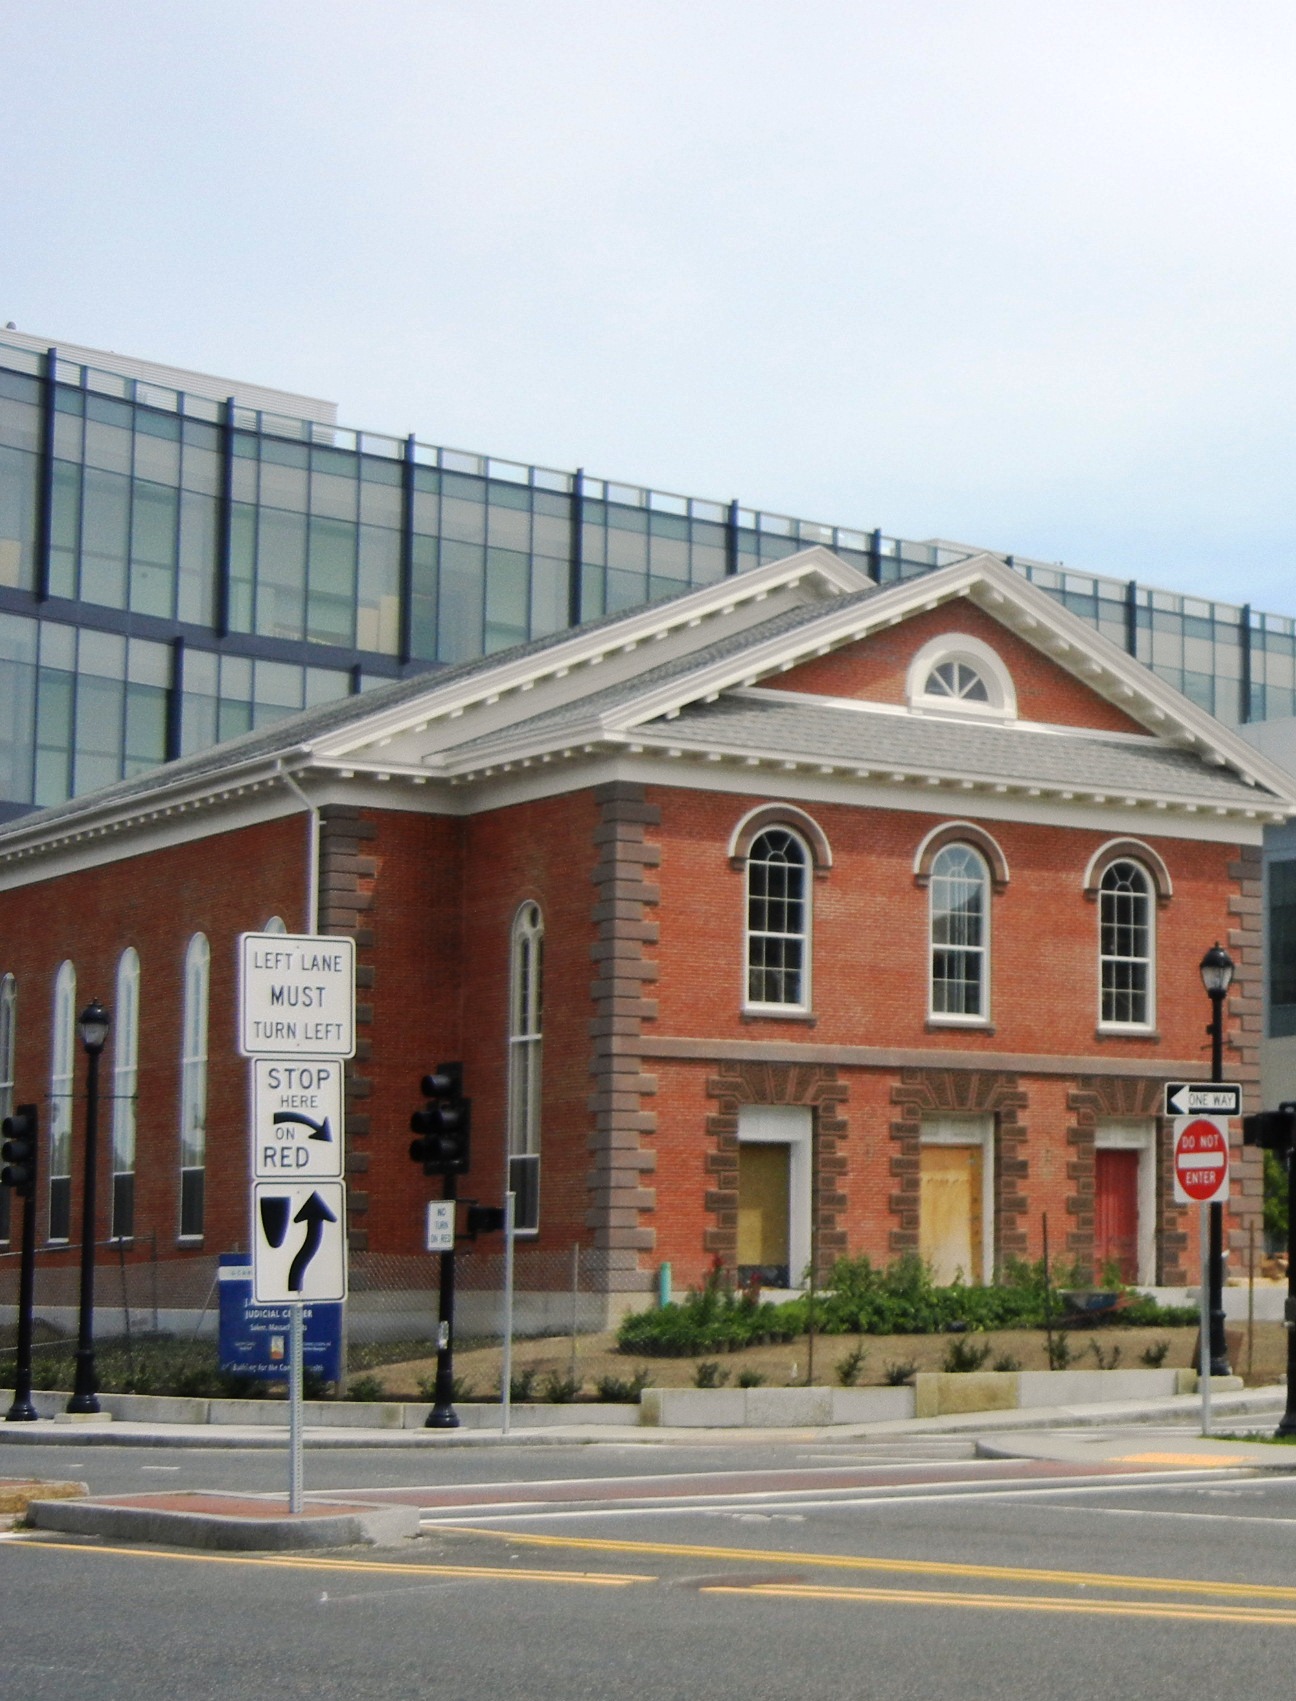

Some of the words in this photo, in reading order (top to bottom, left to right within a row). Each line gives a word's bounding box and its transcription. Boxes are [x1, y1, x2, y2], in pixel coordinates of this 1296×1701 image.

[254, 951, 293, 970] LEFT
[301, 954, 342, 972] LANE
[271, 984, 326, 1008] MUST
[253, 1021, 297, 1039] TURN
[304, 1023, 343, 1040] LEFT
[268, 1068, 331, 1090] STOP
[280, 1095, 318, 1109] HERE
[1188, 1093, 1208, 1106] ONE
[1213, 1093, 1234, 1106] WAY
[275, 1127, 295, 1140] ON
[1181, 1135, 1196, 1149] DO
[1200, 1134, 1220, 1148] NOT
[263, 1146, 310, 1168] RED
[1185, 1171, 1216, 1185] ENTER
[437, 1207, 447, 1217] NO
[435, 1220, 449, 1231] TURN
[430, 1233, 438, 1243] ON
[440, 1233, 452, 1243] RED
[245, 1309, 280, 1320] JUDICIAL
[282, 1309, 313, 1319] CEER
